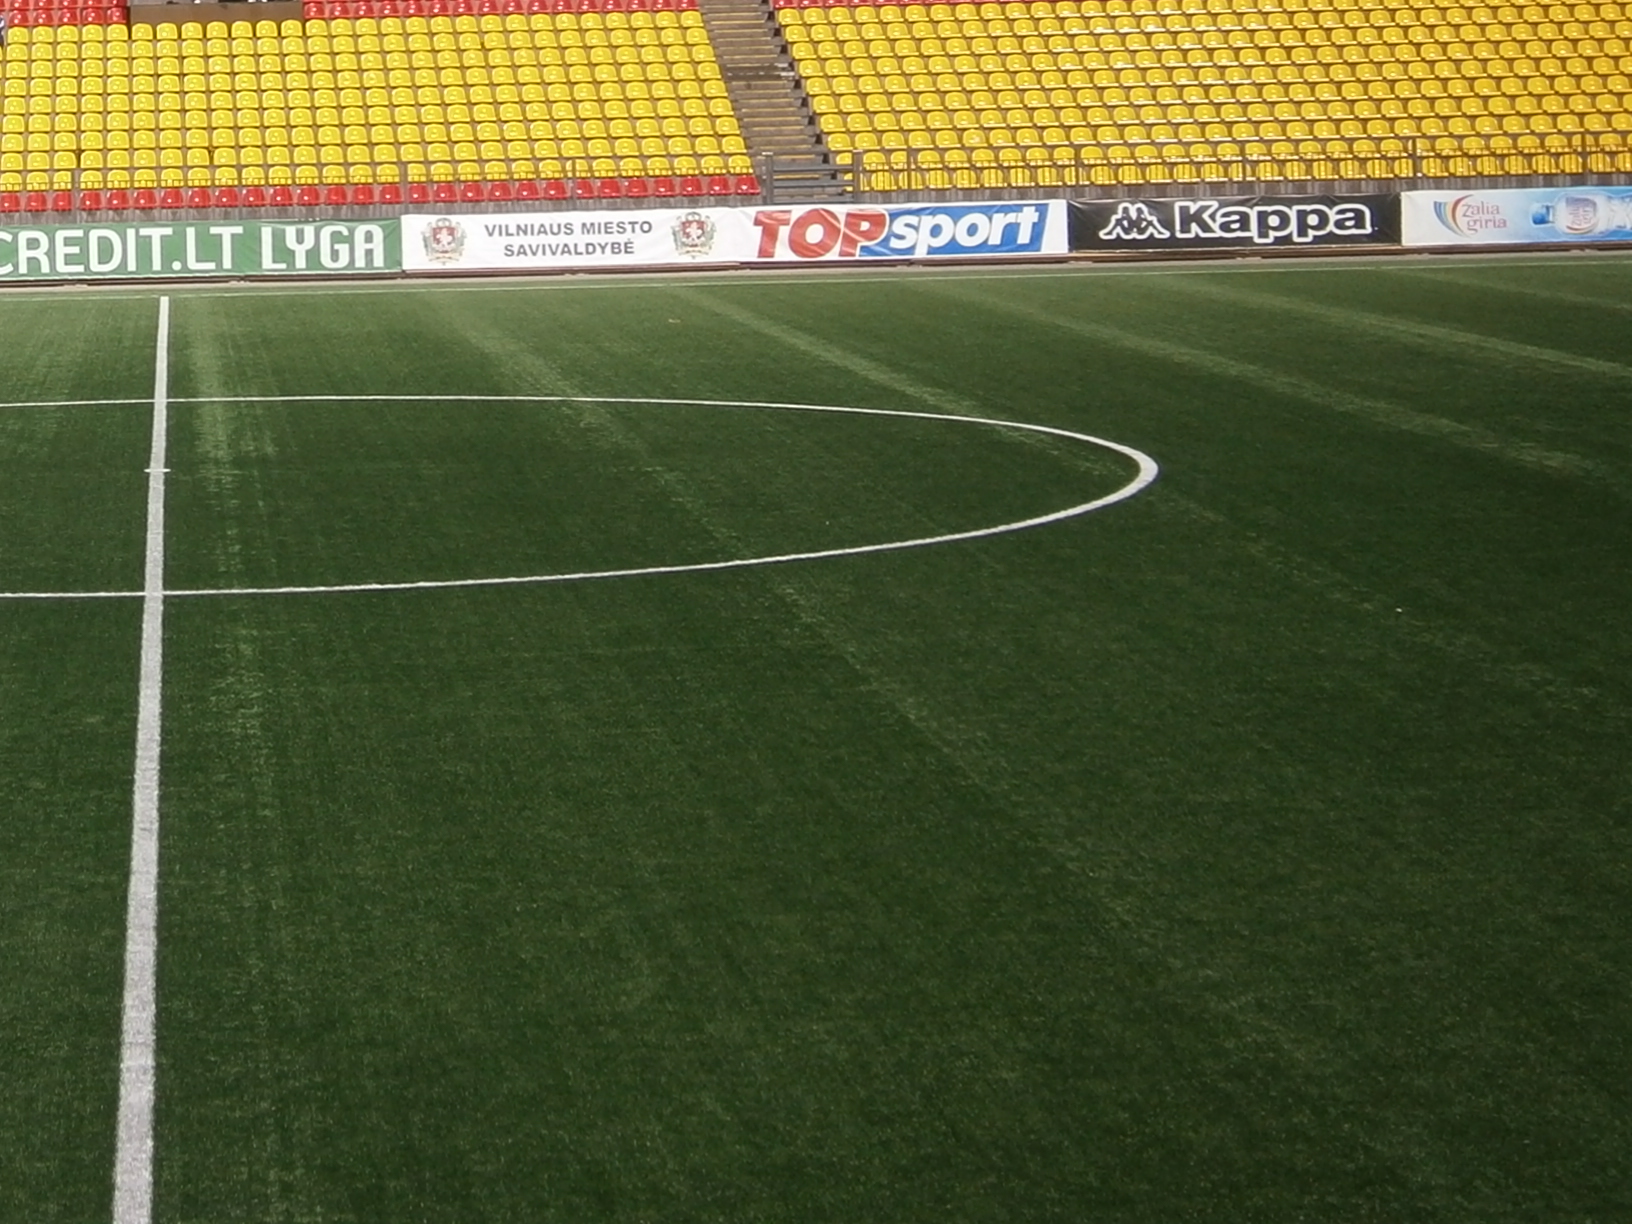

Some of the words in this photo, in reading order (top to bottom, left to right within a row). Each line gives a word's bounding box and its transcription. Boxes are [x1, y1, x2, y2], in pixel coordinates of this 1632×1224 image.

[484, 223, 575, 237] VILNIAUS
[580, 221, 653, 235] MIESTO
[1174, 201, 1373, 243] Kappa
[261, 225, 385, 270] LYGA
[503, 238, 635, 257] SAVIVALDYBĖ
